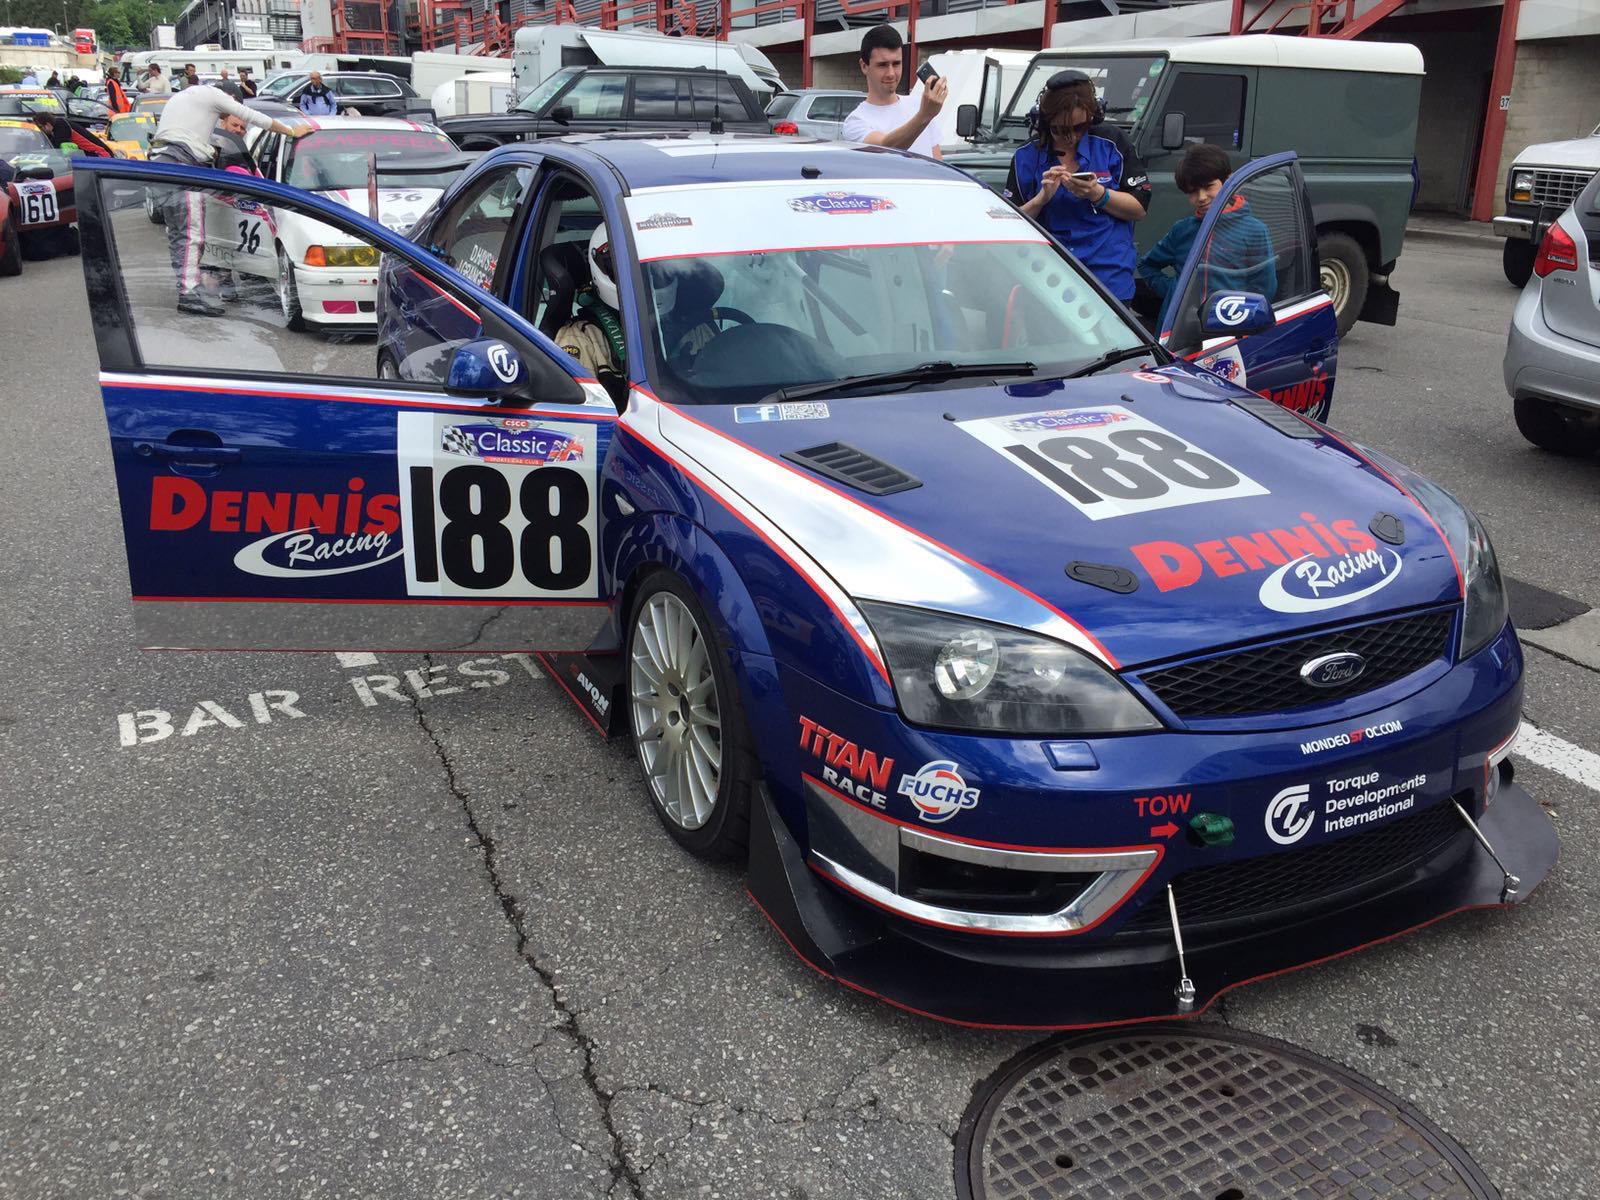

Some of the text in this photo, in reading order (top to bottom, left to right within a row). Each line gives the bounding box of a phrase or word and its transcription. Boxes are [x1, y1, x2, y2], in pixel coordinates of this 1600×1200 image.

[21, 194, 55, 223] 160
[385, 193, 423, 202] 36
[816, 199, 870, 208] Classic
[239, 219, 261, 255] 36
[1037, 415, 1101, 427] Classic
[478, 432, 547, 454] Classic
[1002, 429, 1240, 504] 188
[410, 465, 592, 591] 188
[285, 530, 392, 567] Racing
[1295, 547, 1387, 597] Racing
[1321, 659, 1354, 682] Ford
[119, 652, 545, 748] BAR REST
[577, 672, 609, 711] AVON
[822, 765, 888, 810] RACE
[901, 775, 978, 808] FUCHS
[1325, 774, 1427, 814] Developments
[1327, 771, 1380, 794] Torque
[1134, 793, 1192, 818] TOW
[1324, 794, 1415, 833] International
